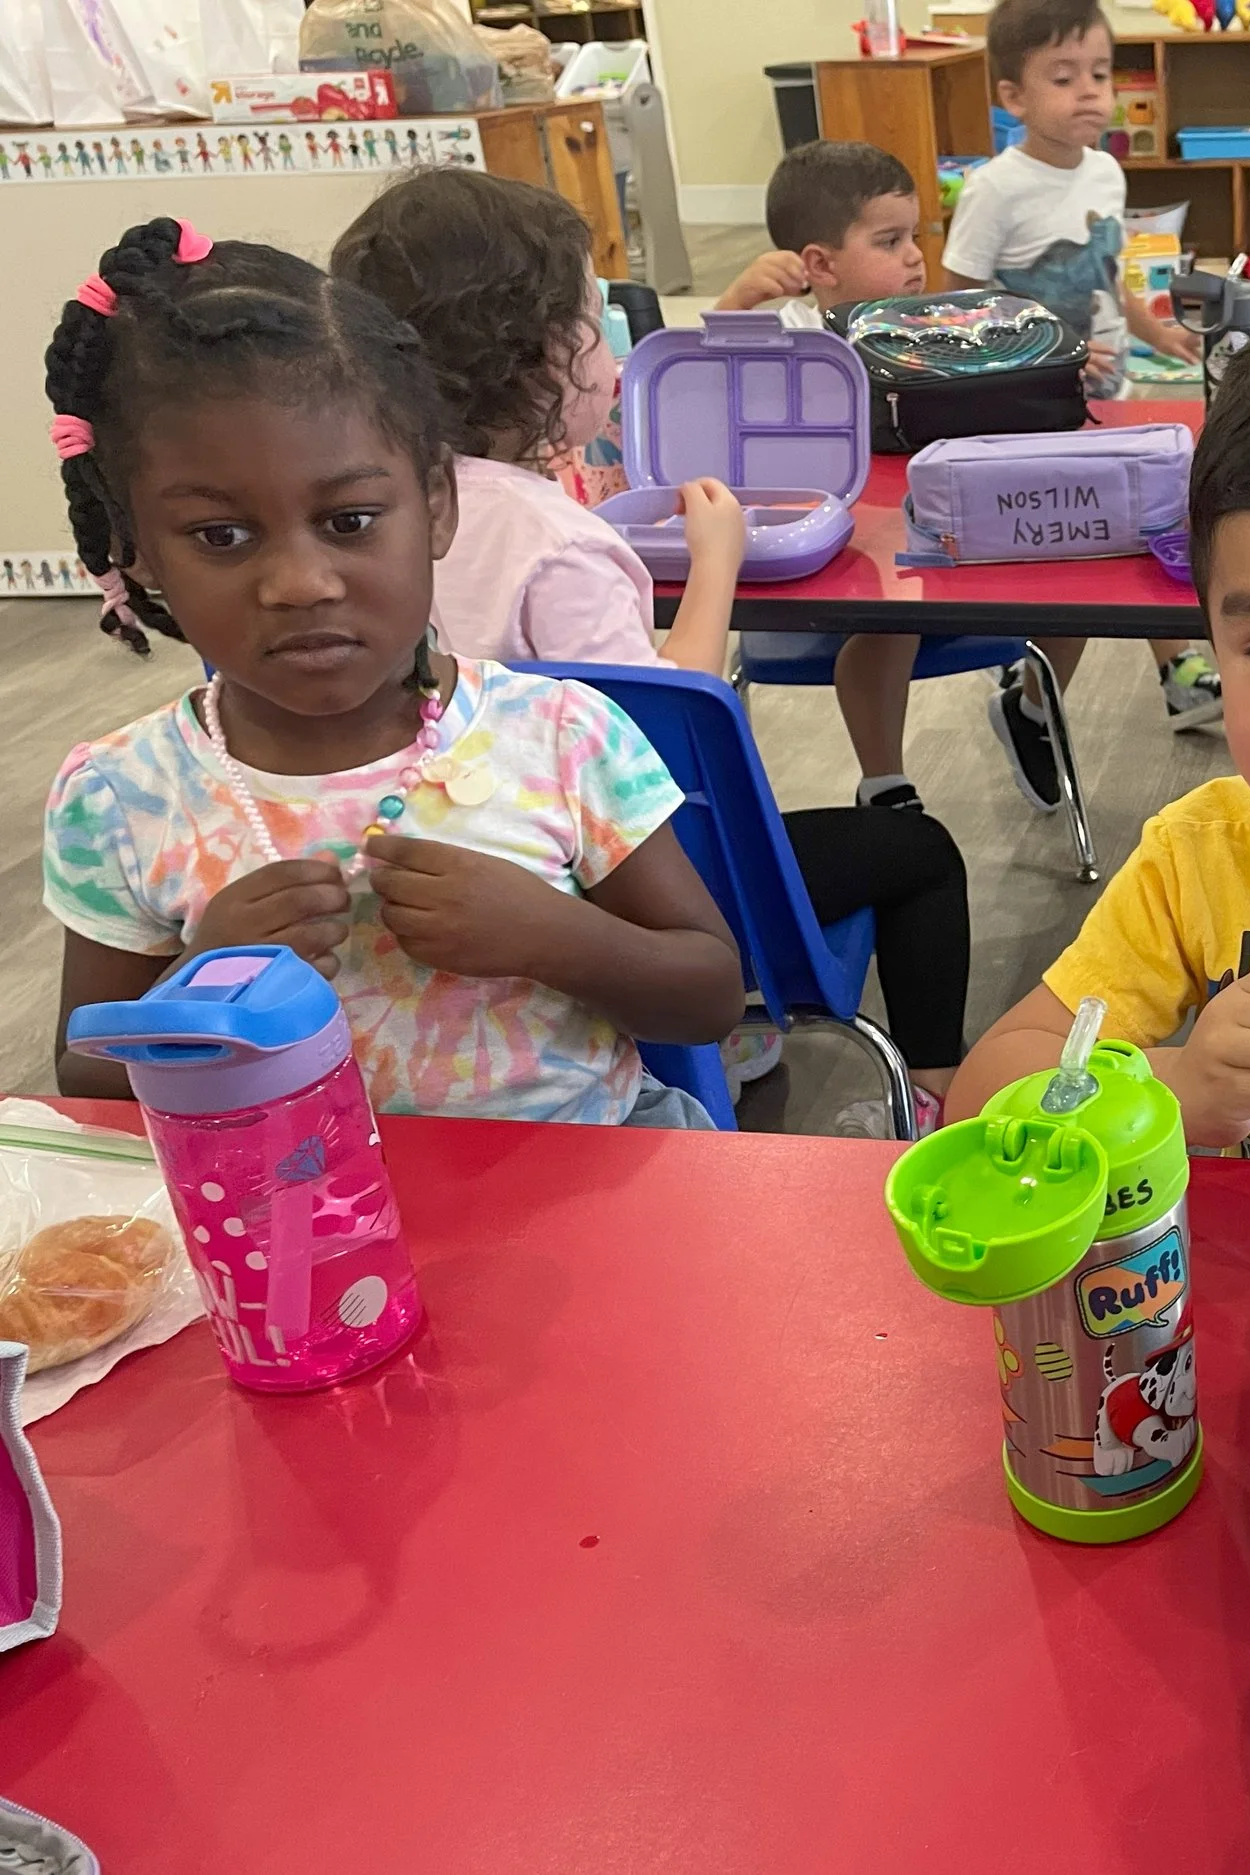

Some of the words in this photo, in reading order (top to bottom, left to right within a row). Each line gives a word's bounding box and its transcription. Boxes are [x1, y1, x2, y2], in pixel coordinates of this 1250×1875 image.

[997, 486, 1100, 515] WILSON
[1013, 517, 1110, 546] EMERY
[1088, 1249, 1180, 1320] Ruff!
